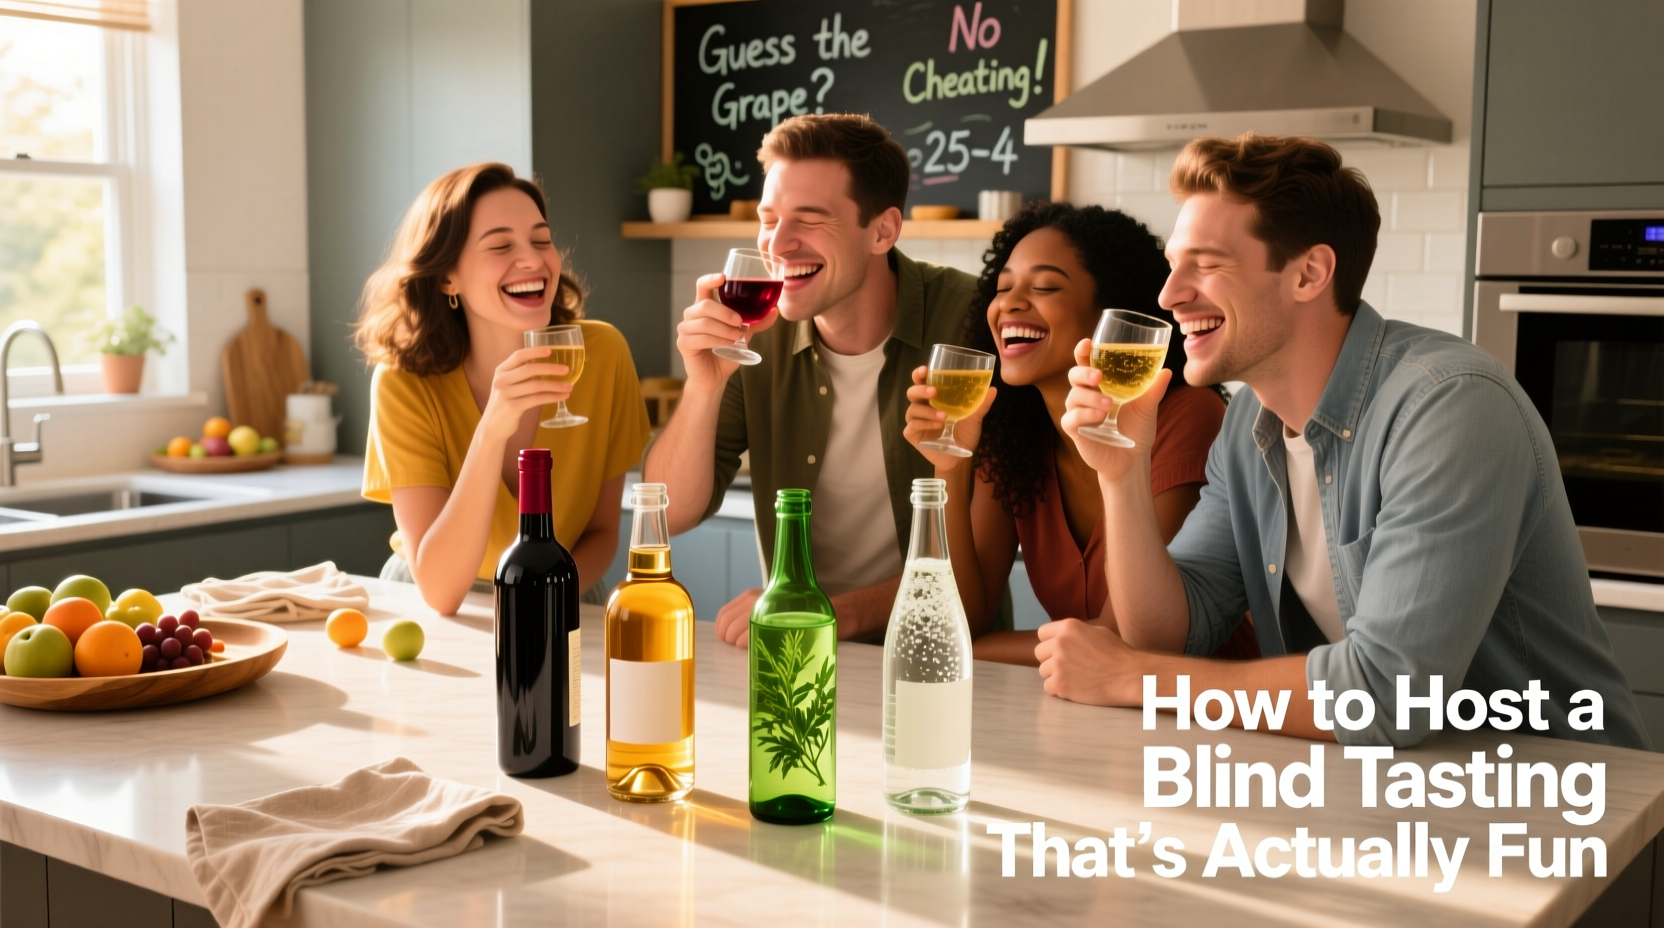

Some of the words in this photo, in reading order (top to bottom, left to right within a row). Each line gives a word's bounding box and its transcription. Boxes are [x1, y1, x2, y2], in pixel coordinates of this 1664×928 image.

[699, 24, 797, 76] Guess
[812, 12, 872, 61] the
[947, 1, 1002, 54] No
[711, 66, 835, 130] Grape?
[902, 37, 1049, 109] Cheating!
